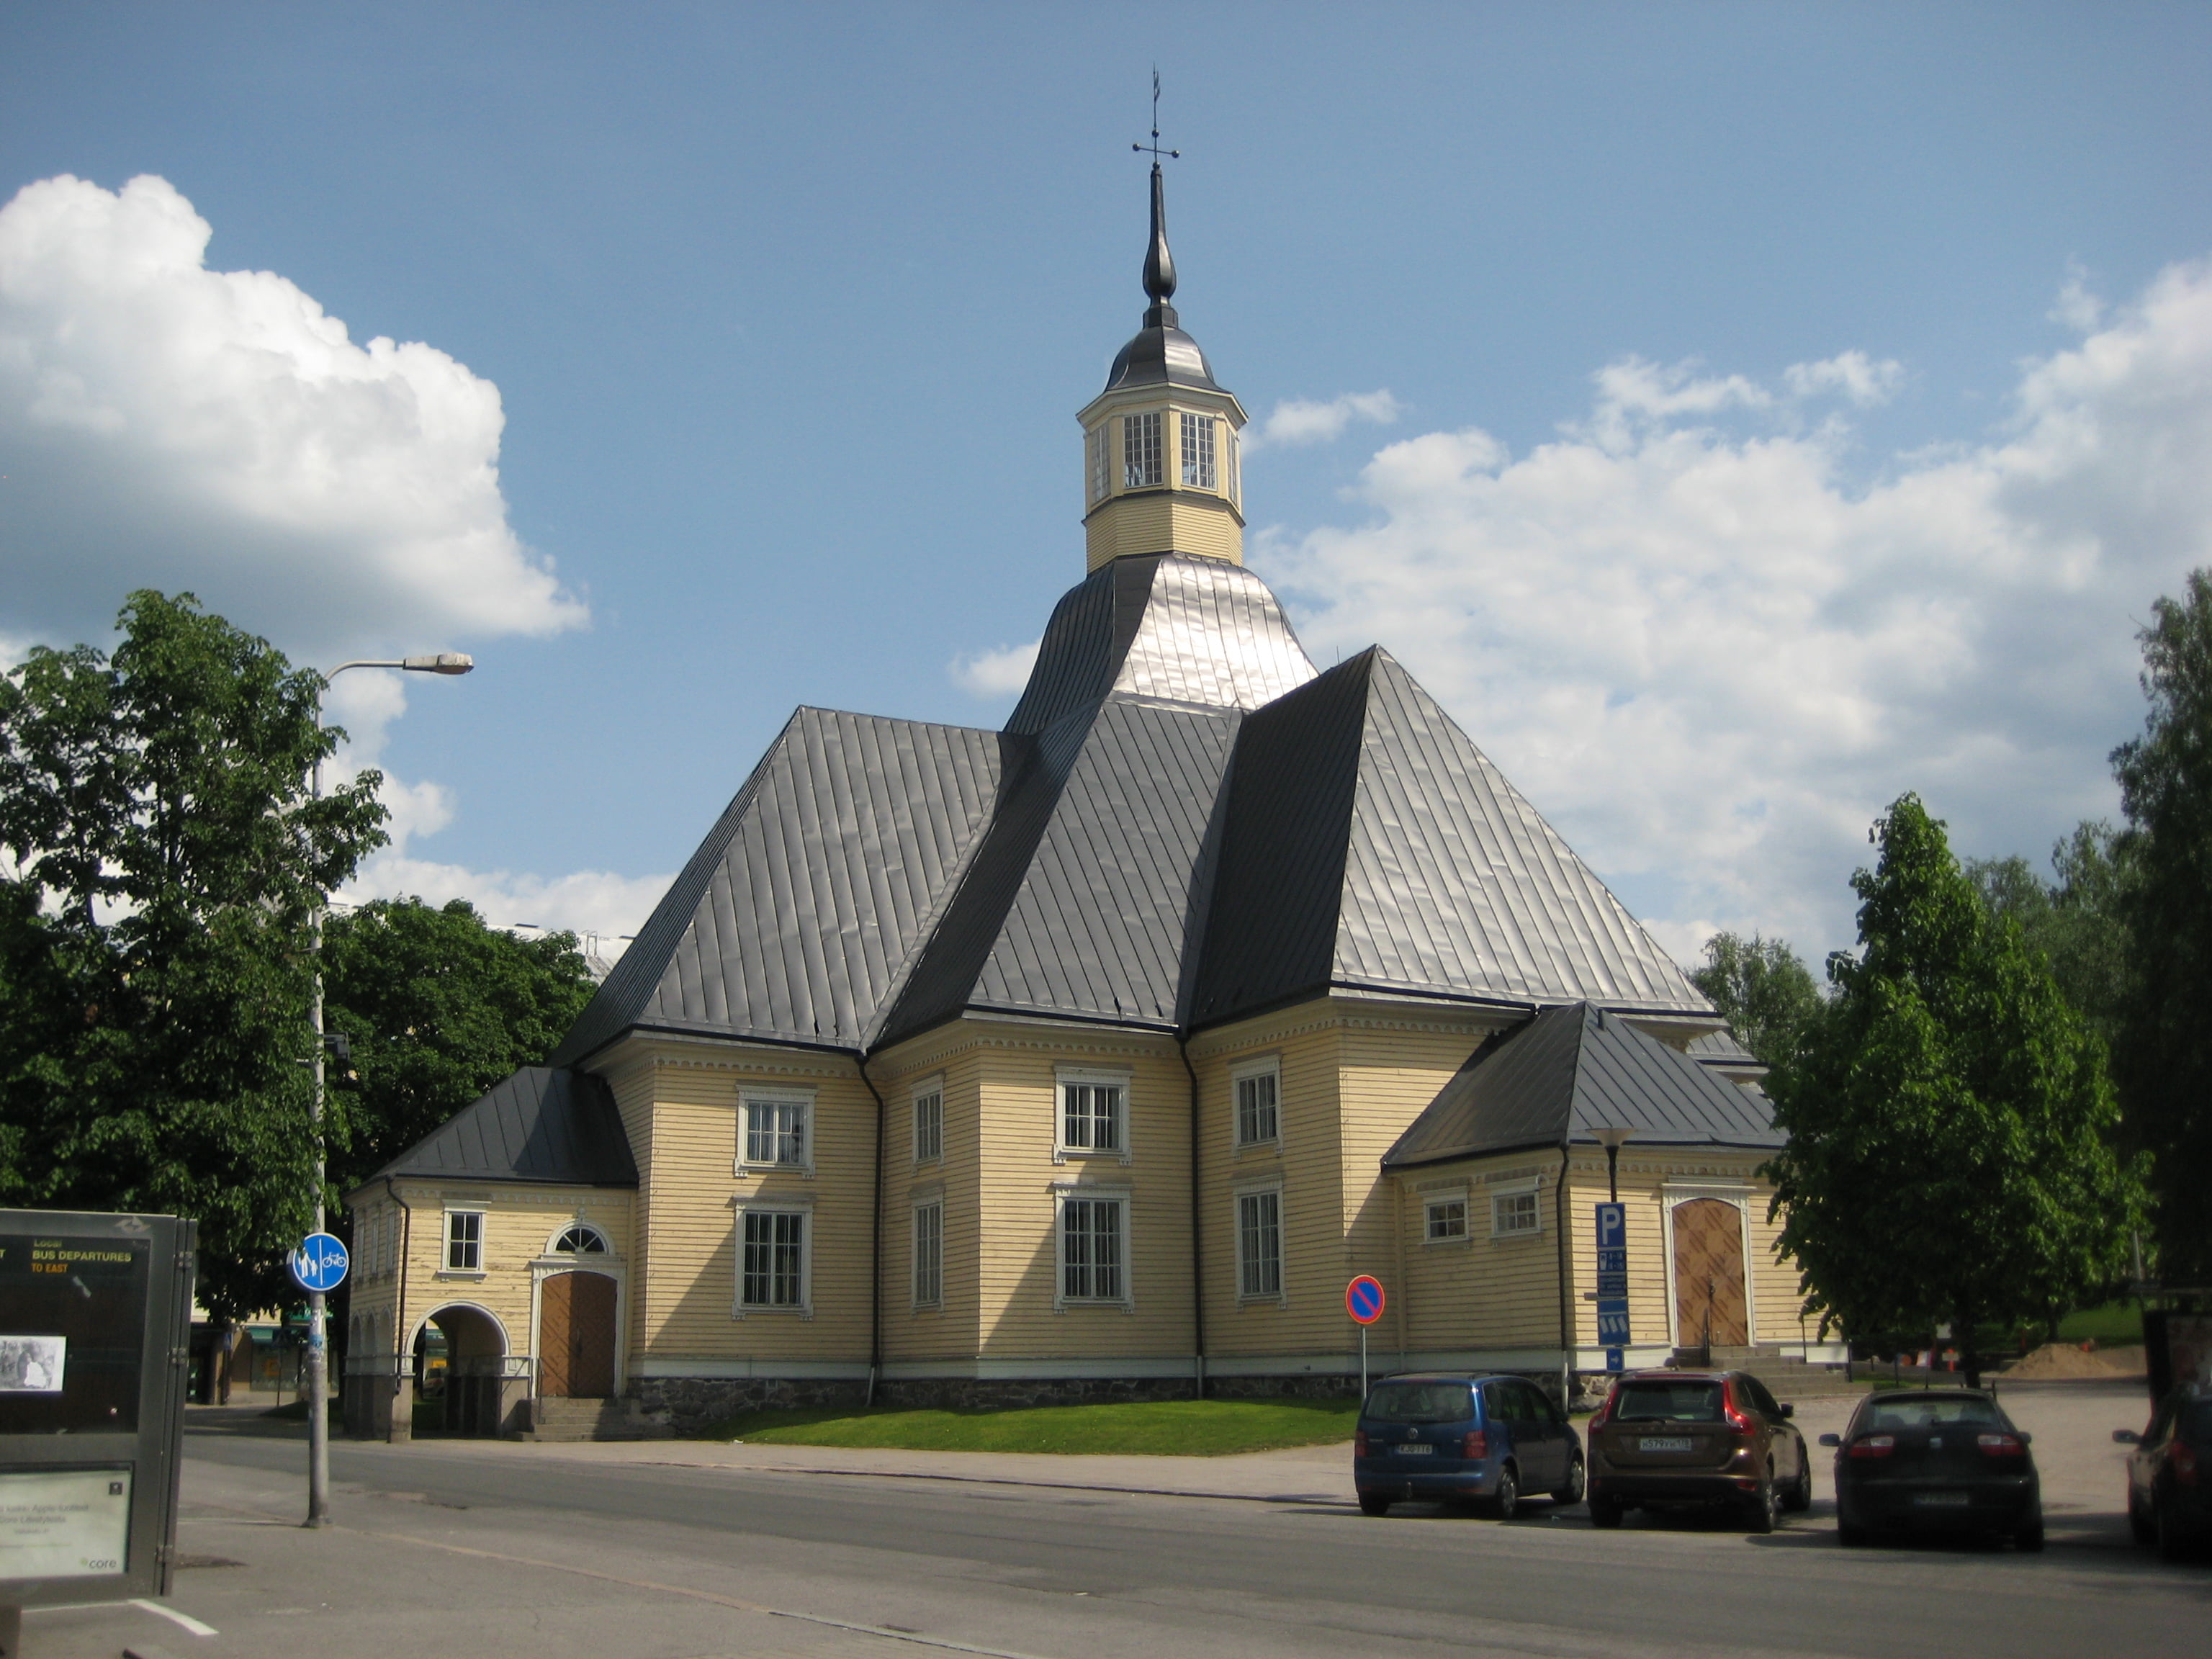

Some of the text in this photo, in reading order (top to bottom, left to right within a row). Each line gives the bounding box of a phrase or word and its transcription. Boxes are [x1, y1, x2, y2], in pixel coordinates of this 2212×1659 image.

[1601, 1208, 1620, 1244] P
[32, 1250, 132, 1262] BUS DEPARTURES
[32, 1263, 69, 1273] TO EAST
[89, 1558, 117, 1568] core
